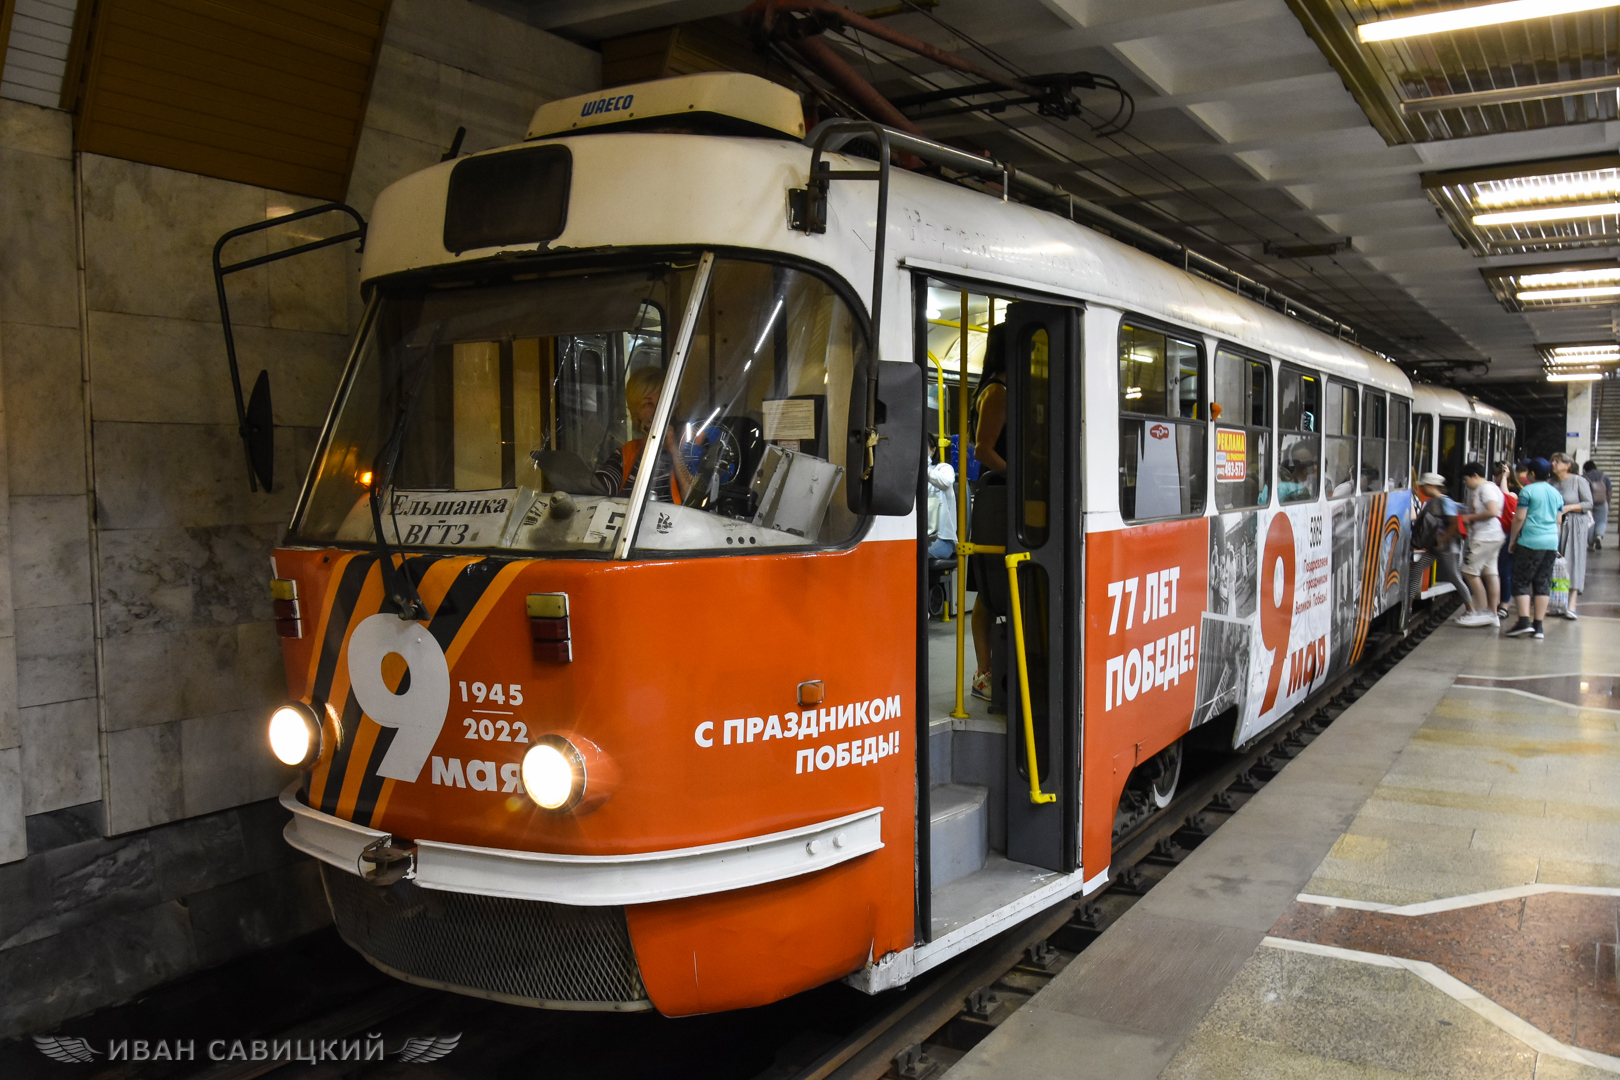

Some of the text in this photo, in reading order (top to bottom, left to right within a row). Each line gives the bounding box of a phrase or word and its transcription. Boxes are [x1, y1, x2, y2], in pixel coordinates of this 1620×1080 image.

[581, 94, 634, 117] WAECO
[1217, 433, 1245, 452] РЕКЛАМА
[387, 494, 508, 516] Ельшанка
[403, 524, 470, 545] ВГТЗ
[1107, 566, 1180, 636] 77 ЛЕТ
[1258, 511, 1296, 718] 9
[1105, 625, 1195, 712] ПОБЕДЕ!
[348, 613, 450, 783] 9
[458, 681, 524, 706] 1945
[462, 717, 529, 744] 2022
[694, 694, 902, 748] С ПРАЗДНИКОМ
[795, 730, 900, 774] ПОБЕДЫ!
